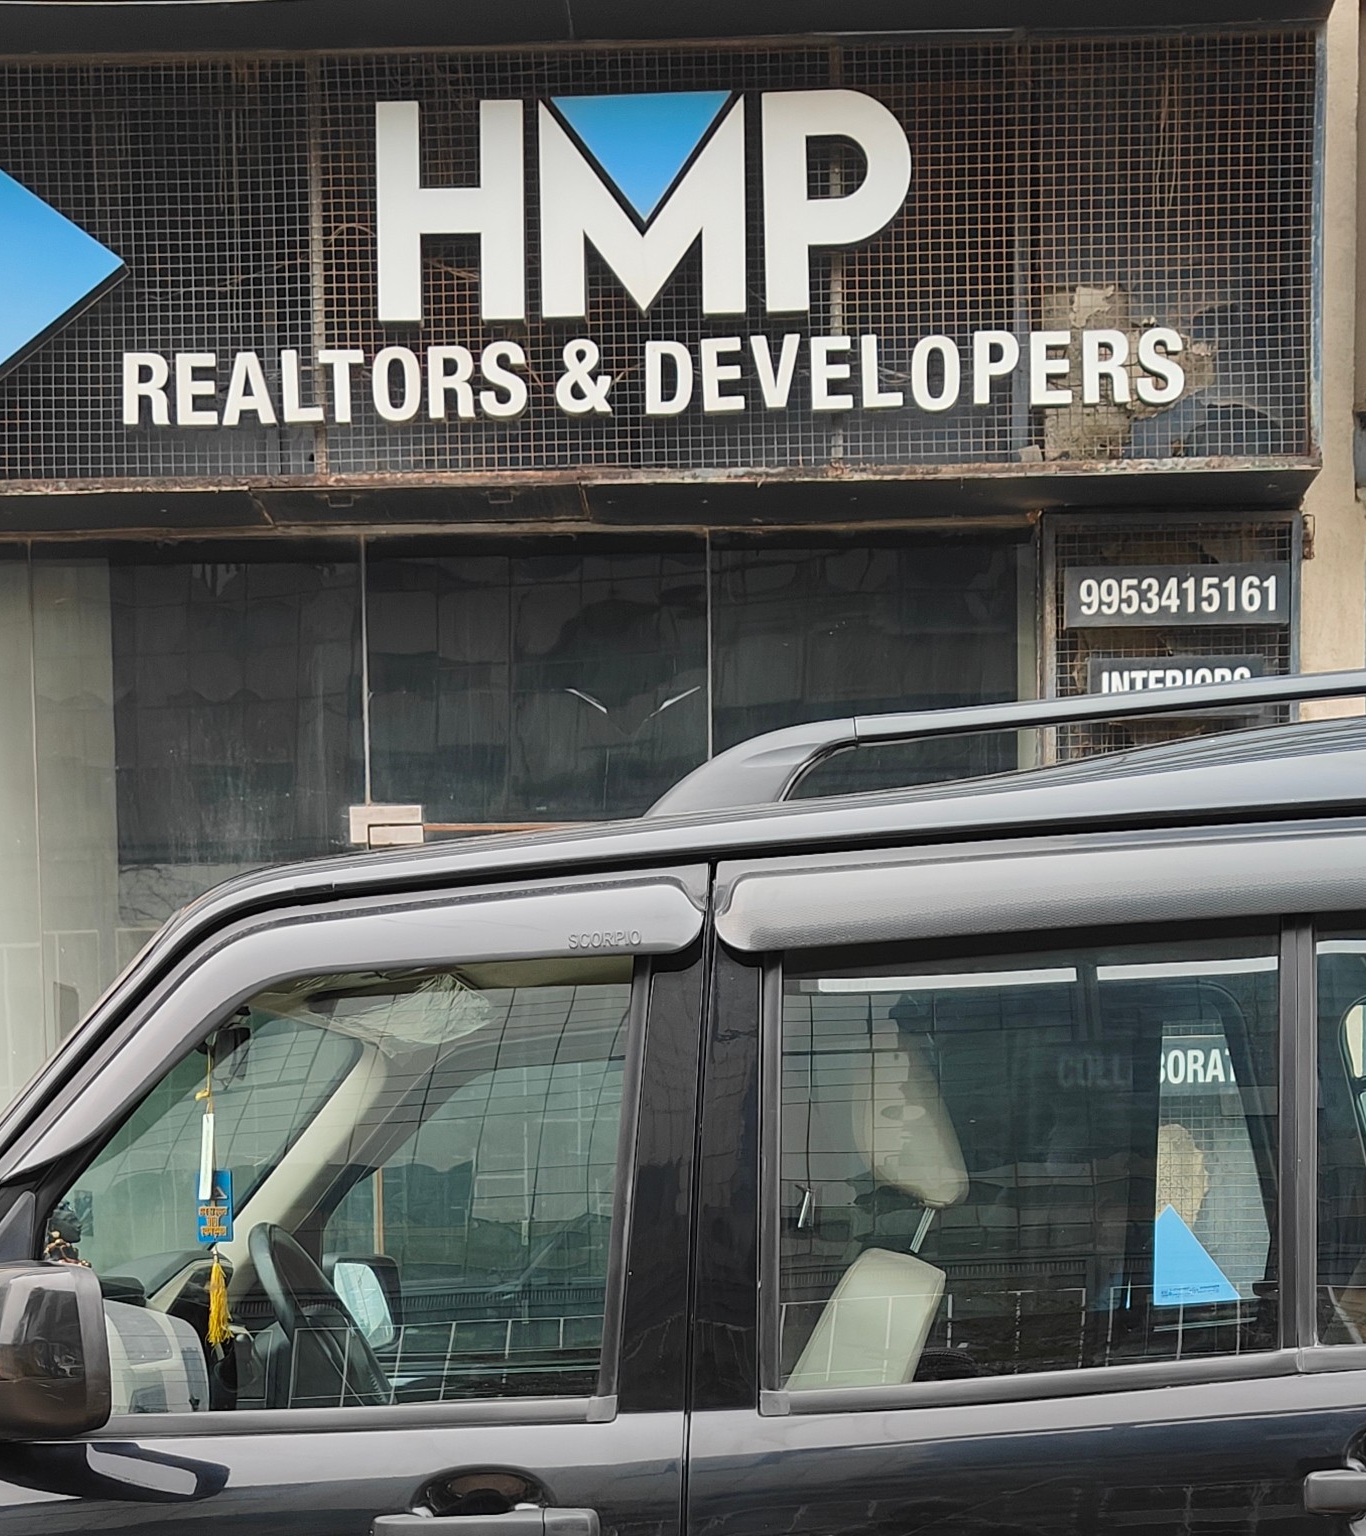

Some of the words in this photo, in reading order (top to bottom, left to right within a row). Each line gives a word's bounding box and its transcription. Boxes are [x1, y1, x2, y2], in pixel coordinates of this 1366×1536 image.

[376, 88, 913, 322] HMP
[122, 340, 528, 427] REALTORS
[556, 338, 613, 416] &
[644, 327, 1186, 416] DEVELOPERS
[1079, 574, 1278, 616] 9953415161
[568, 930, 642, 950] SCORPIO
